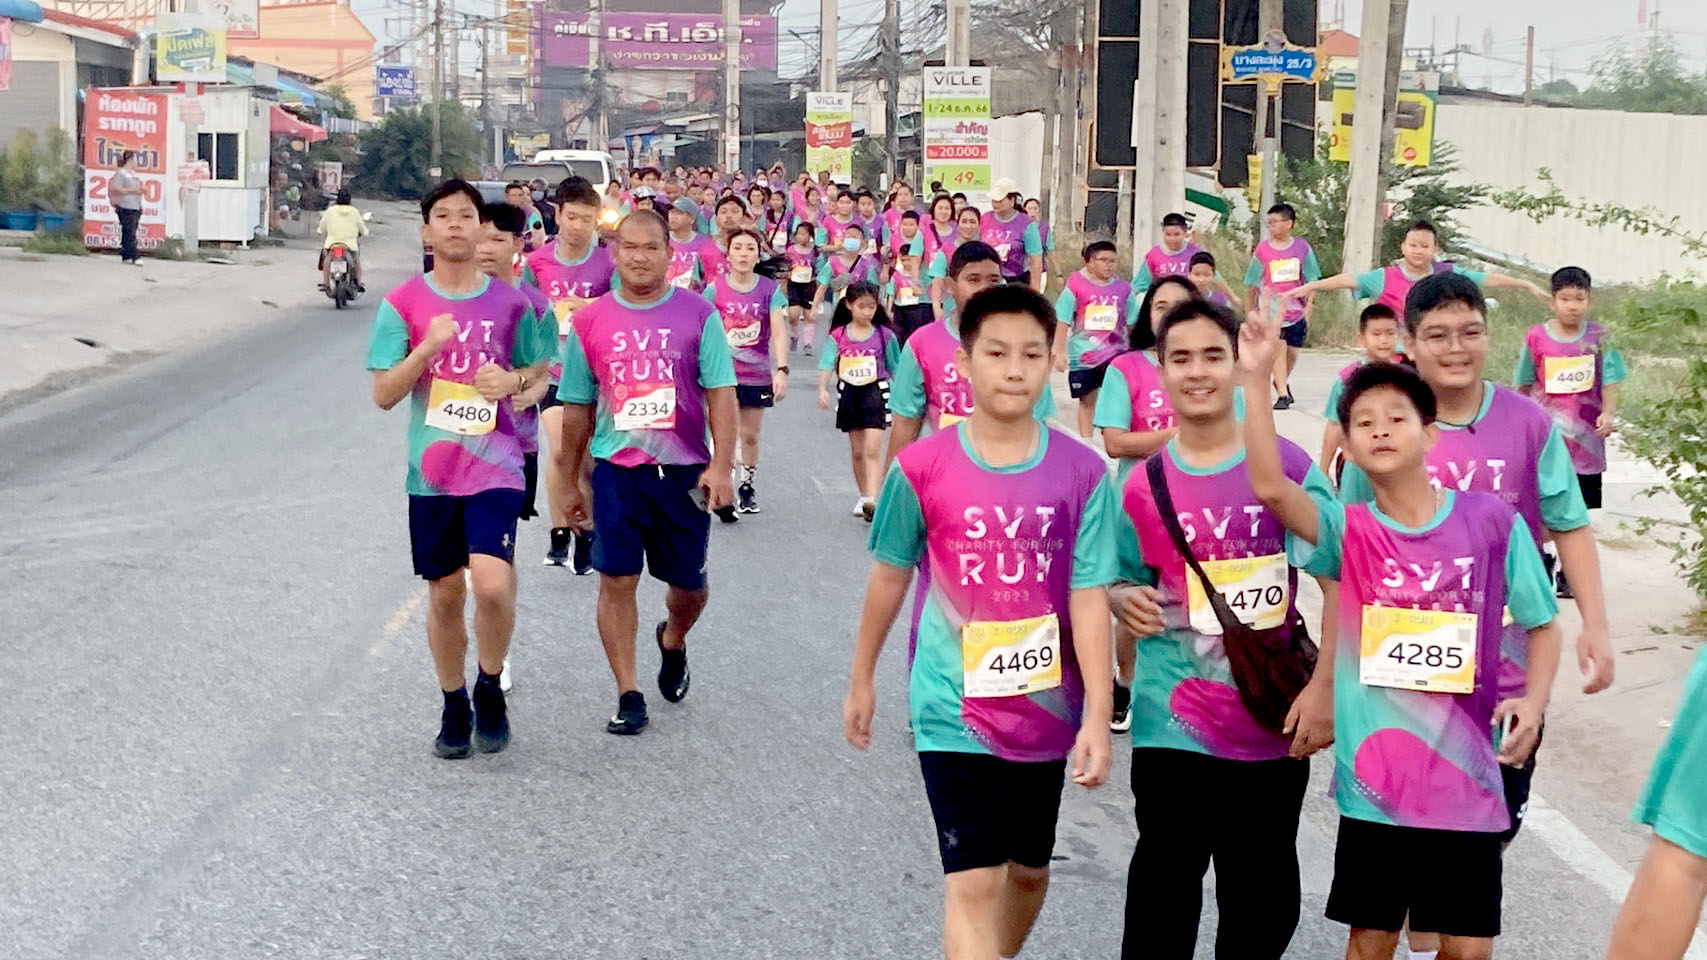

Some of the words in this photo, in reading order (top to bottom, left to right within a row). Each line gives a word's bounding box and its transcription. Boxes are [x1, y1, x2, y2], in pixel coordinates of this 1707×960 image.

[1287, 58, 1312, 69] 25/3
[934, 76, 982, 86] VILLE
[98, 94, 158, 115] ห้องพัก
[98, 117, 158, 137] ราคาถูก
[1159, 262, 1187, 274] SVT
[550, 280, 593, 298] SVT
[727, 303, 760, 315] SVT
[454, 319, 495, 343] VT
[612, 329, 672, 352] SVT
[731, 330, 758, 340] 2047
[609, 358, 675, 384] RUN
[1557, 371, 1592, 383] 4407
[443, 403, 492, 423] 4480
[628, 402, 669, 417] 2334
[963, 506, 1056, 539] SVT
[1381, 557, 1475, 592] SVT
[992, 590, 1030, 602] 2023
[1225, 585, 1284, 611] 470
[988, 646, 1054, 674] 4469
[1387, 643, 1464, 670] 4285
